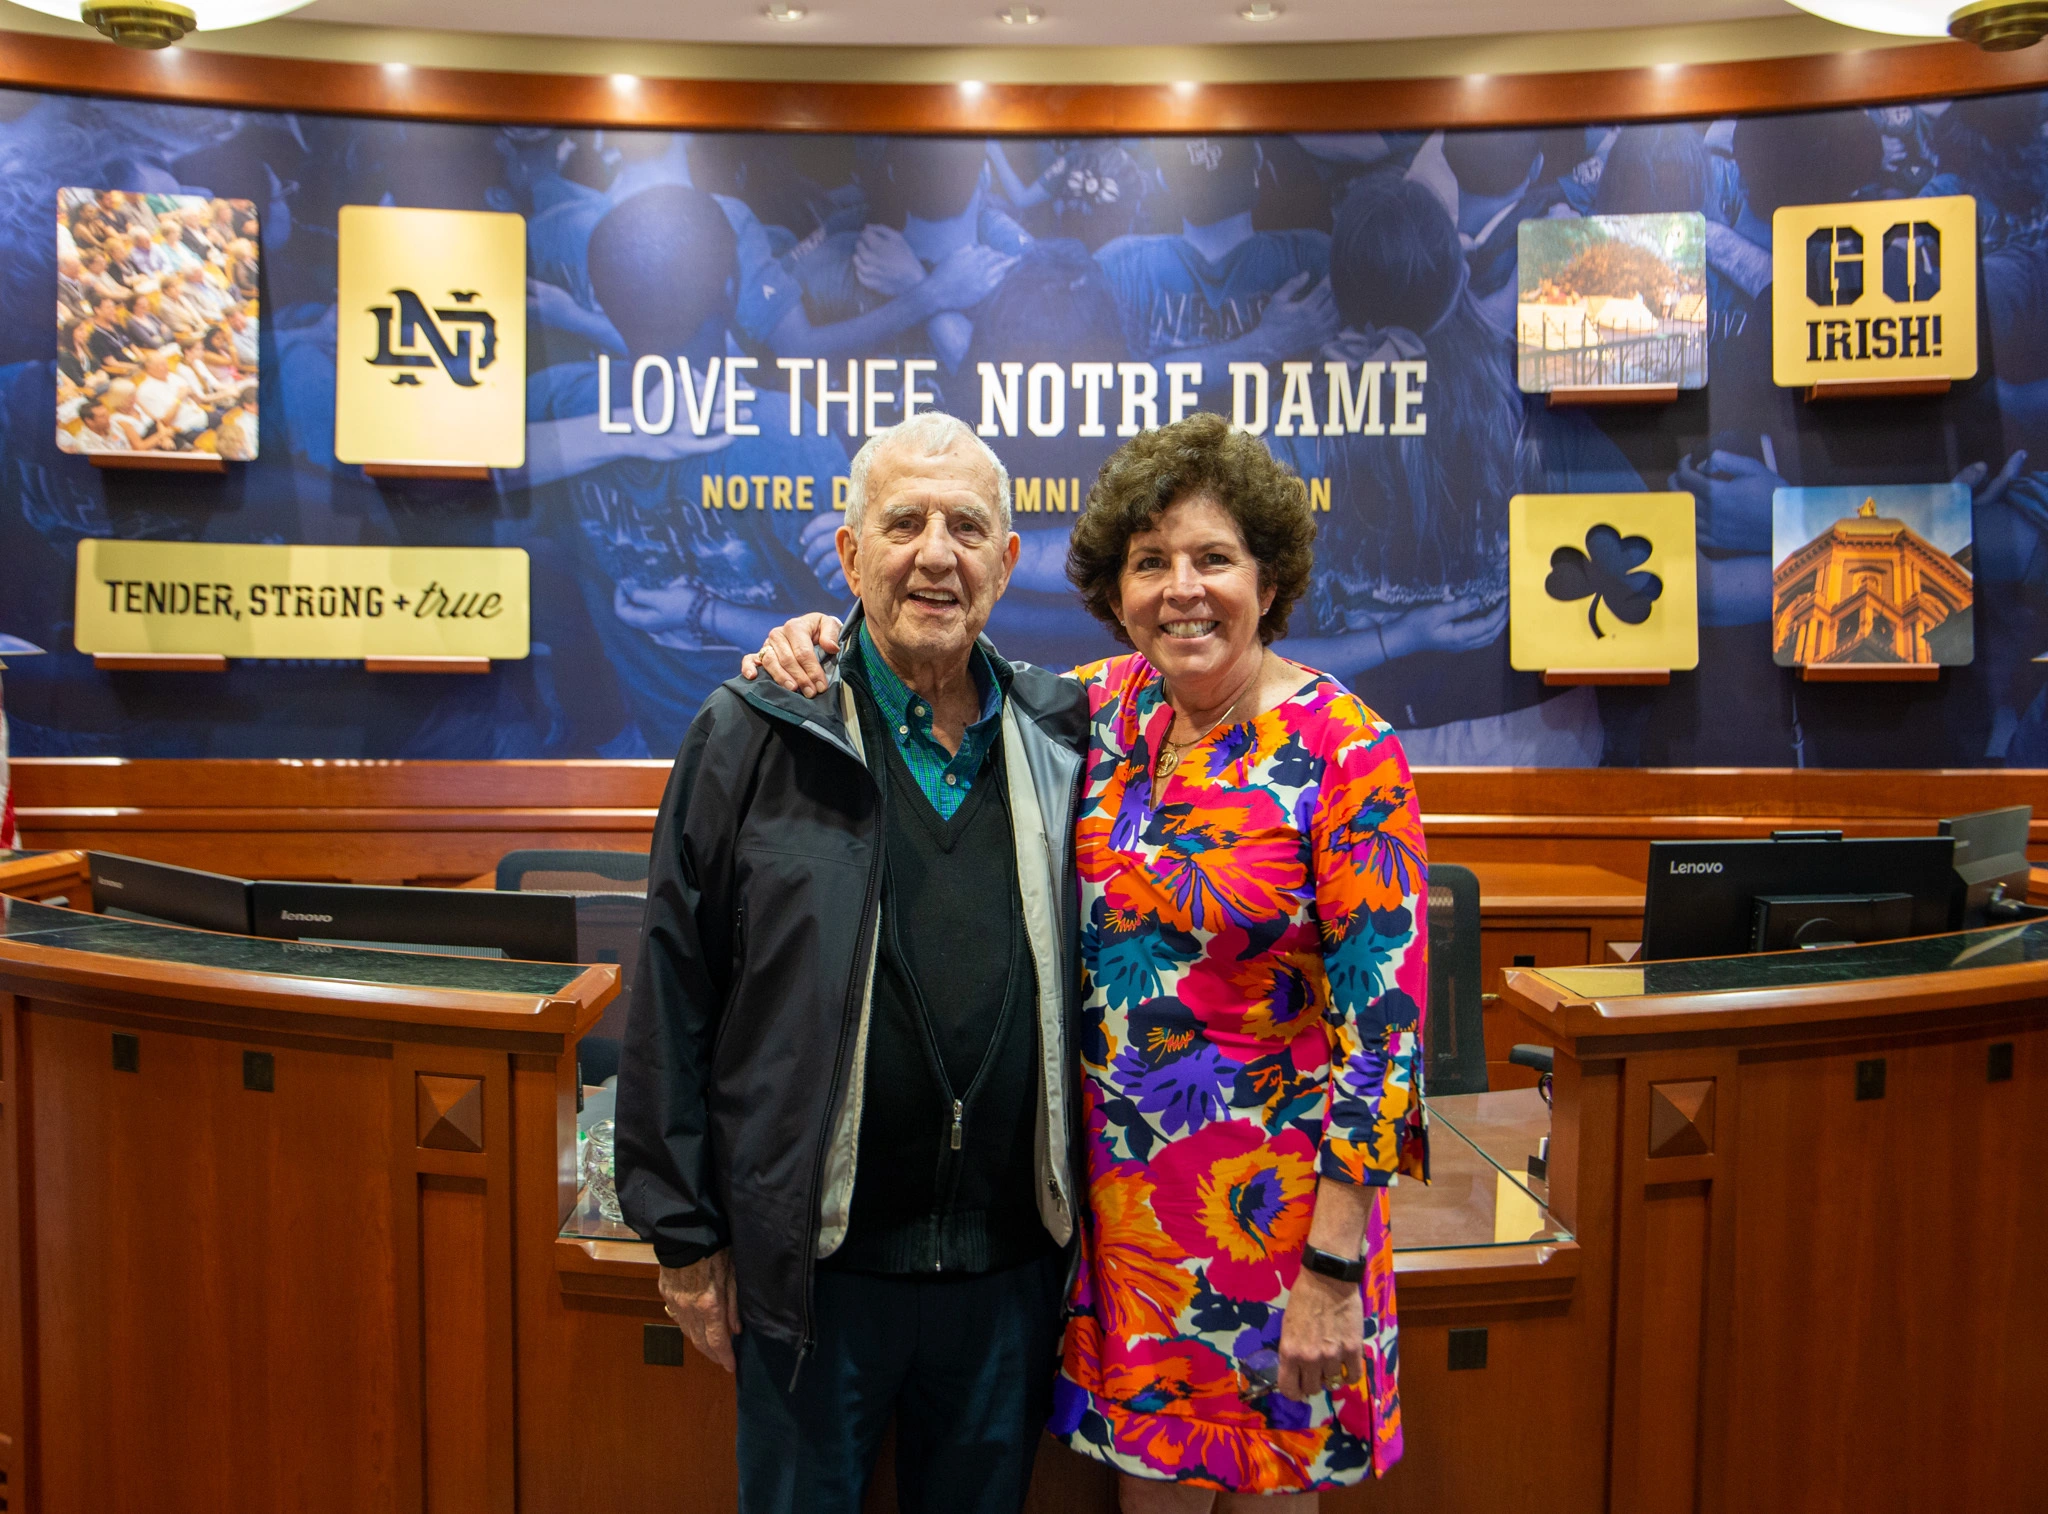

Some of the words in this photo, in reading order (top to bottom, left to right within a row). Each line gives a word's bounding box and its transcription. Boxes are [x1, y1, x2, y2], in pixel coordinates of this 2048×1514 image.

[1805, 220, 1942, 308] GO
[1805, 314, 1943, 363] IRISH!
[598, 354, 762, 436] LOVE
[775, 357, 938, 437] THEE
[976, 361, 1203, 437] NOTRE
[1228, 360, 1428, 437] DAME
[701, 474, 815, 511] NOTRE
[1008, 476, 1080, 513] MNI
[104, 579, 241, 622] TENDER,
[249, 584, 384, 618] STRONG
[413, 580, 503, 618] true
[1669, 860, 1724, 875] Lenovo
[281, 909, 333, 923] lenovo
